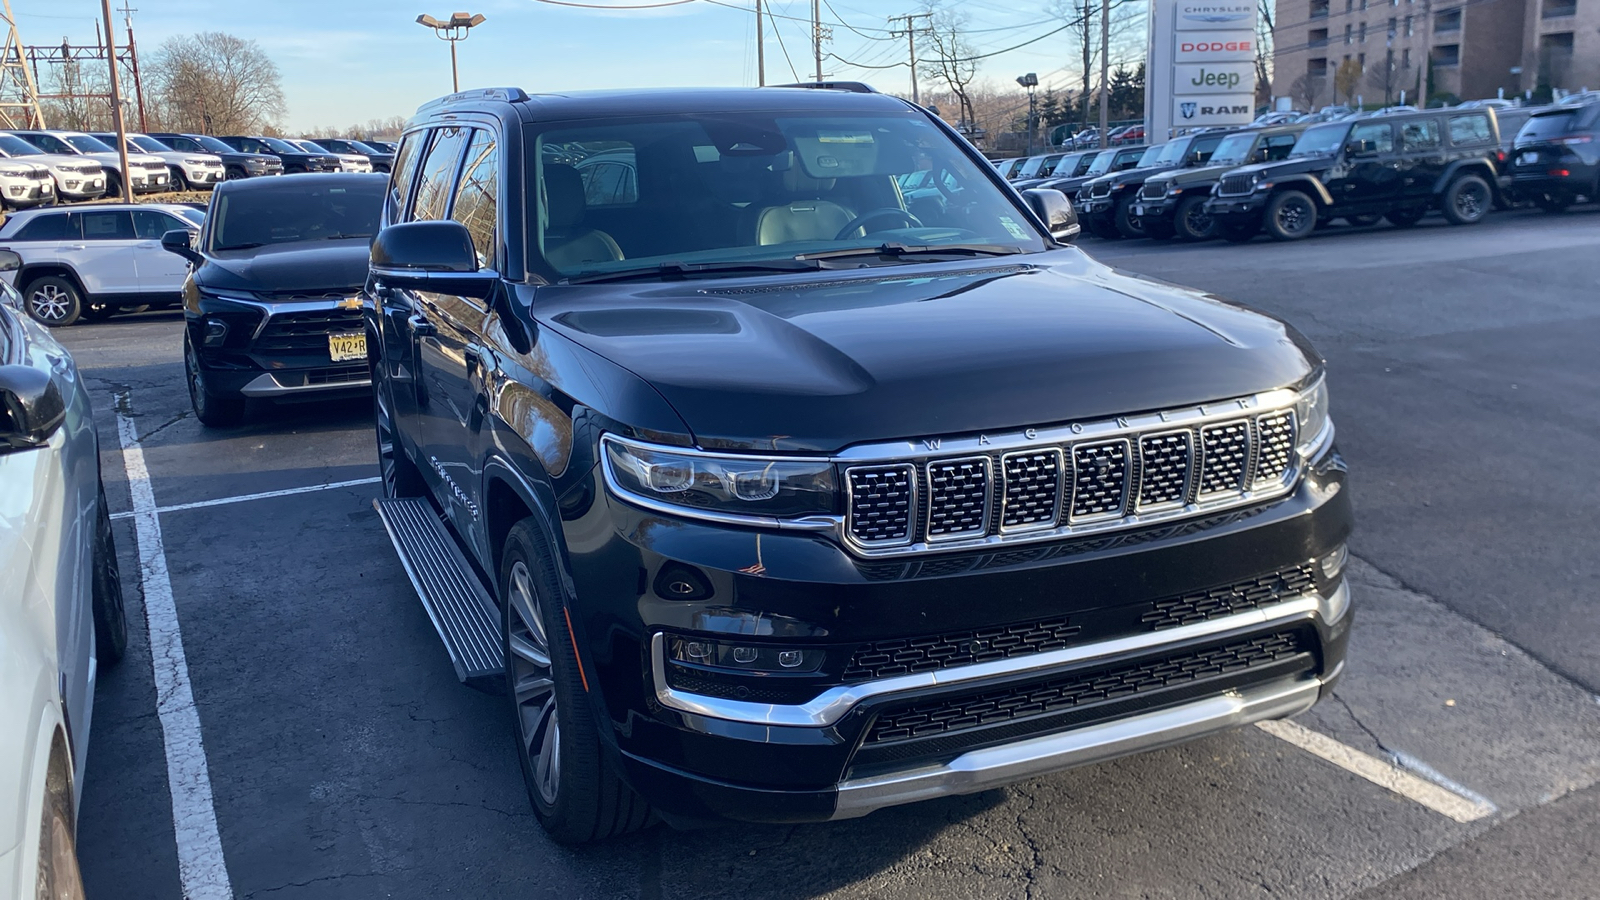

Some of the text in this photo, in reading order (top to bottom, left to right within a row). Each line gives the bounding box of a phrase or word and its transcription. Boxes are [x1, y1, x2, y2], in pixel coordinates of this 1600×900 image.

[1181, 42, 1251, 52] DODGE
[1191, 68, 1240, 89] Jeep
[1201, 106, 1248, 115] RAM
[922, 398, 1249, 451] WAGONEER
